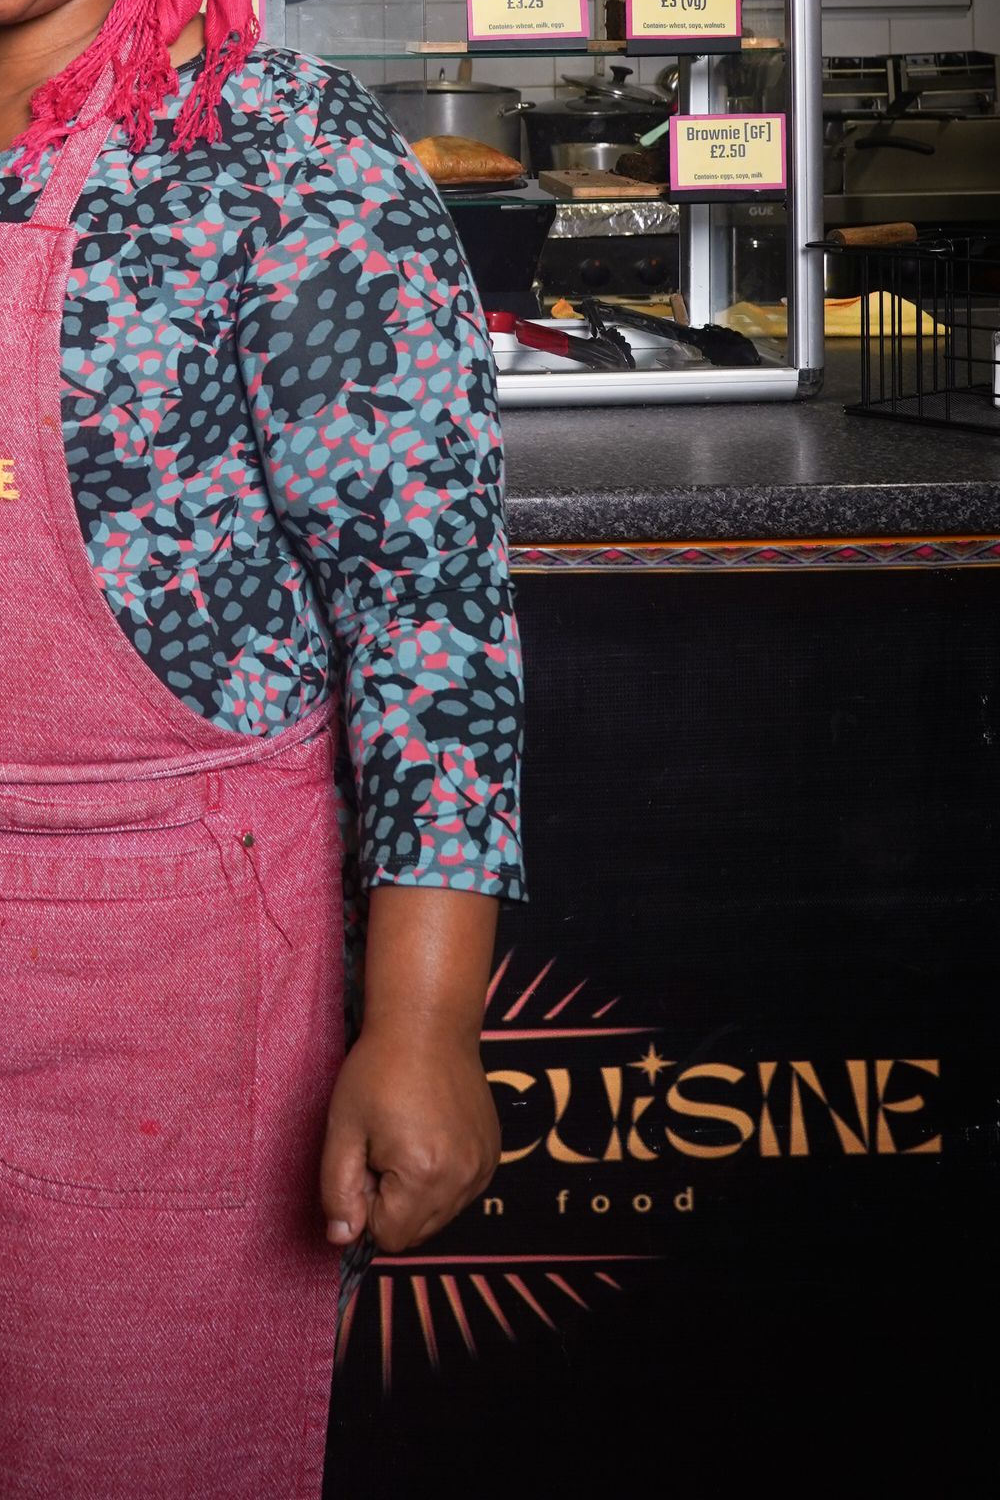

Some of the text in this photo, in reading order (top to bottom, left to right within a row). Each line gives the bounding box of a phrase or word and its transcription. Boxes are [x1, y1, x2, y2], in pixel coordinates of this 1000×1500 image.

[686, 121, 772, 143] Brownie [GF]
[710, 143, 746, 159] £2.50
[750, 171, 763, 179] milk
[555, 1187, 694, 1214] food
